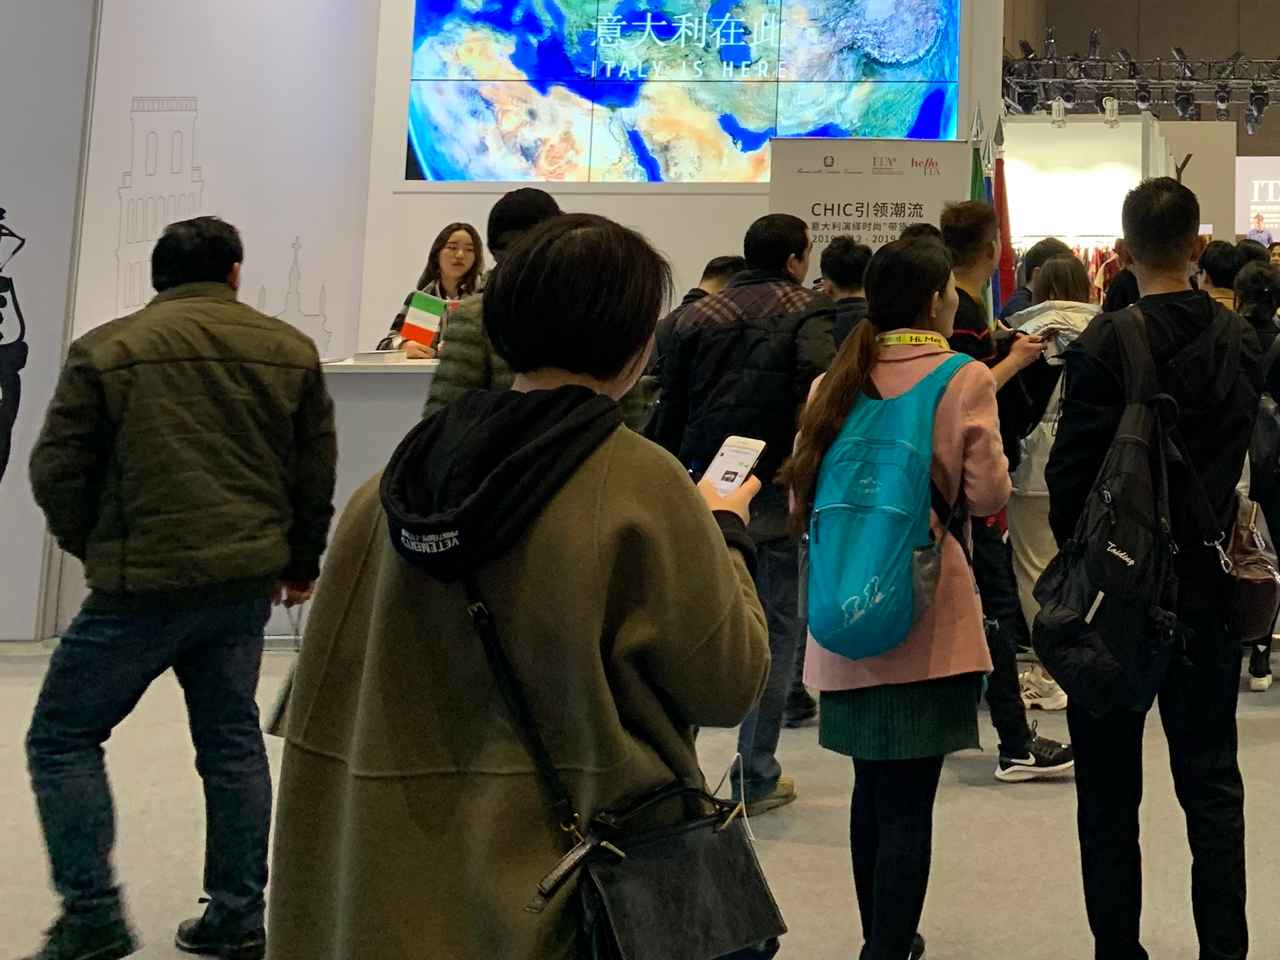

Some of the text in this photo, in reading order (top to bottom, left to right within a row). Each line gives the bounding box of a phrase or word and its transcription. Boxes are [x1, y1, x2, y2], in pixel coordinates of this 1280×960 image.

[591, 12, 787, 48] 意大利在此
[591, 60, 788, 79] ITALY IS HERE
